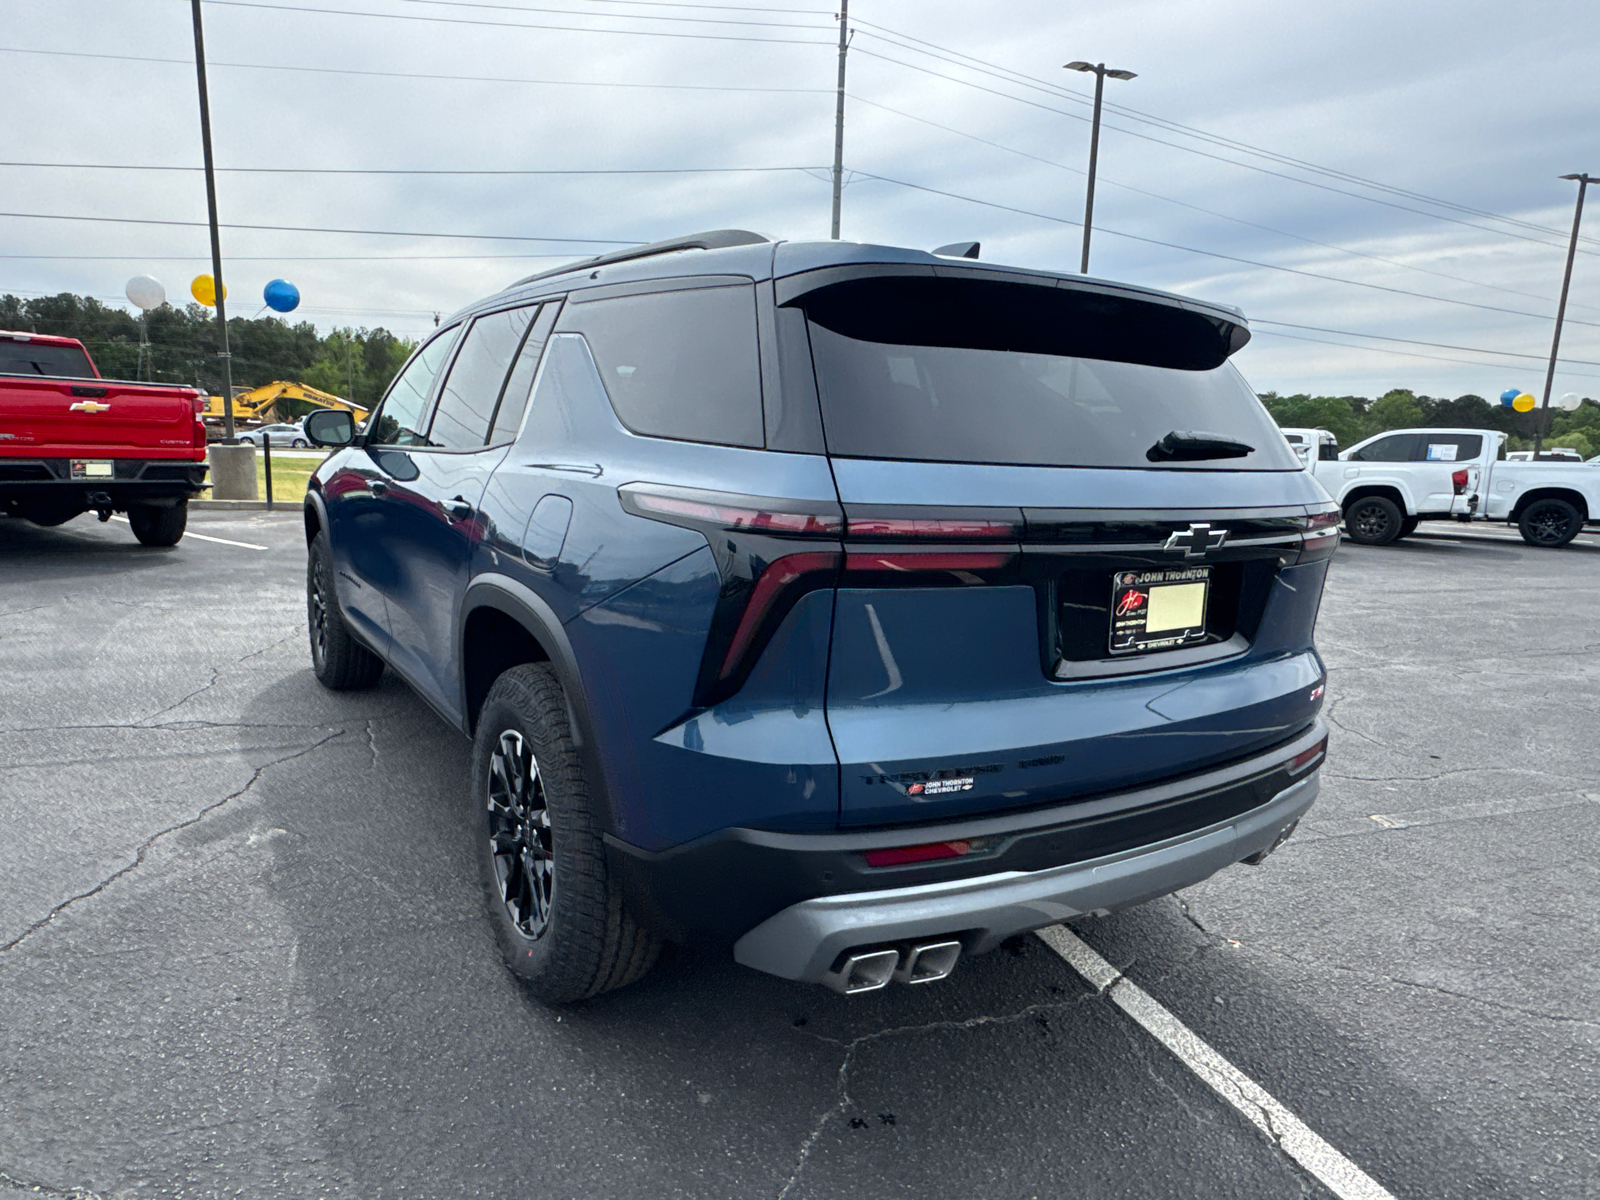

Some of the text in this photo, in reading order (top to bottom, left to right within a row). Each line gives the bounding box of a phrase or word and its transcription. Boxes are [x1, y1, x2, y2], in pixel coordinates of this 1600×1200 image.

[1139, 568, 1209, 583] JOHN THORNTON
[925, 777, 974, 789] JOHN THORNTON
[924, 785, 962, 795] CHEVROLET
